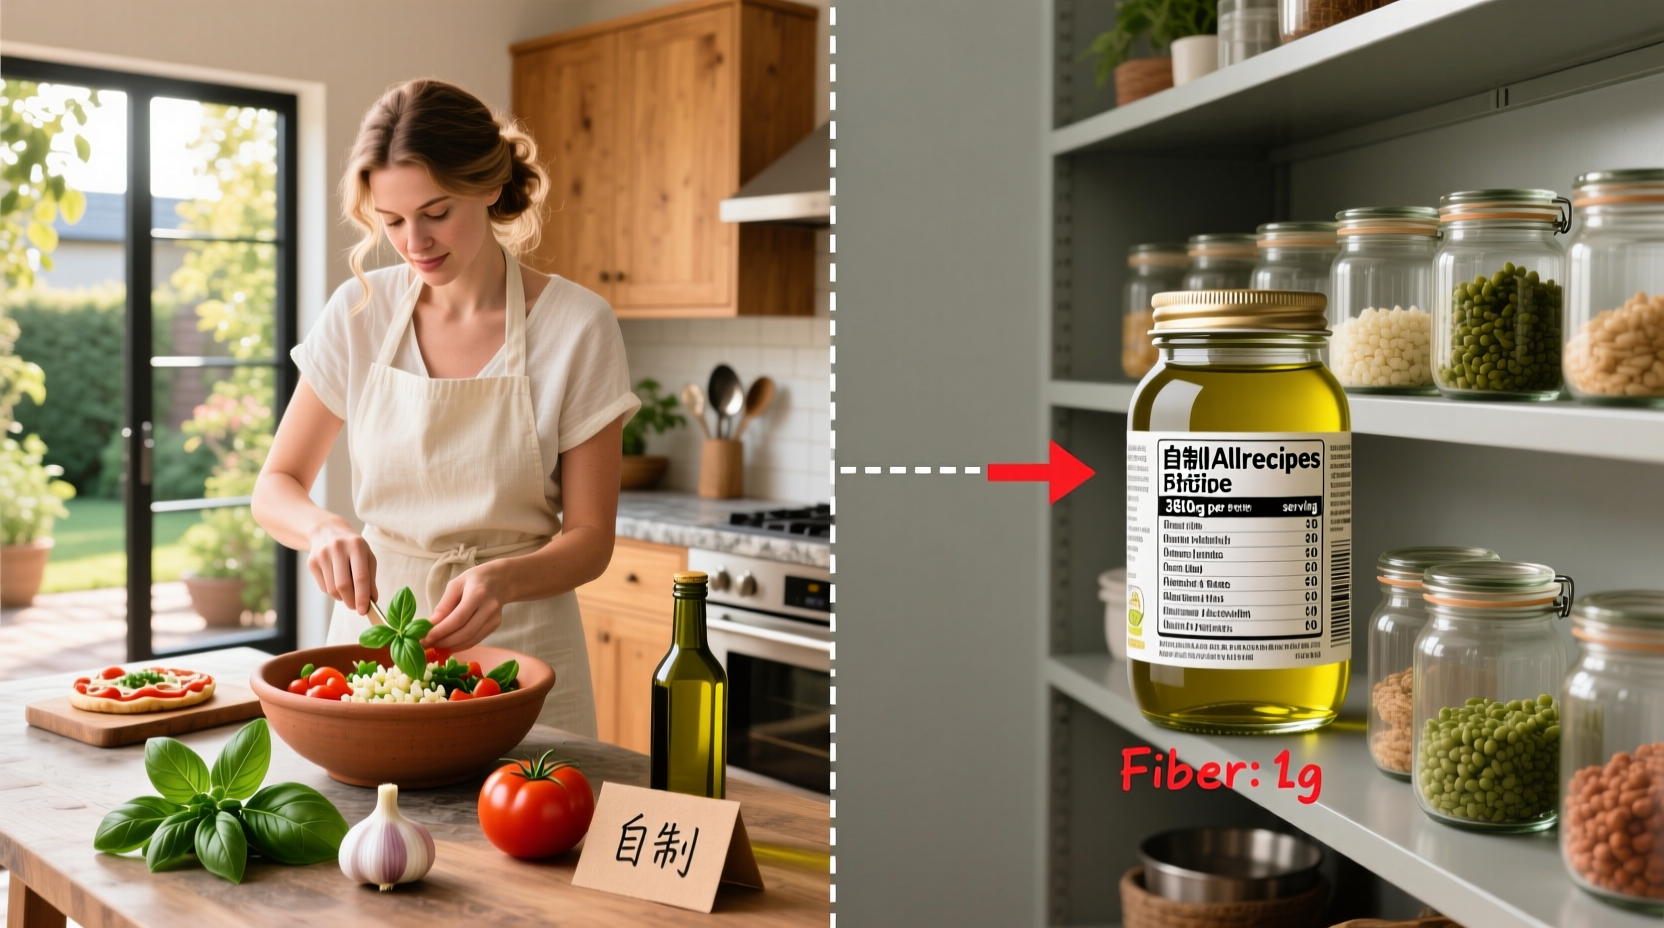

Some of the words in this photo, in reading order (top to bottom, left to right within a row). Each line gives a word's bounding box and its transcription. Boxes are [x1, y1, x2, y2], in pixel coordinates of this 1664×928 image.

[1164, 445, 1209, 470] 自制
[1211, 446, 1321, 474] Allrecipes
[1282, 500, 1318, 515] serving
[615, 813, 700, 878] 自制
